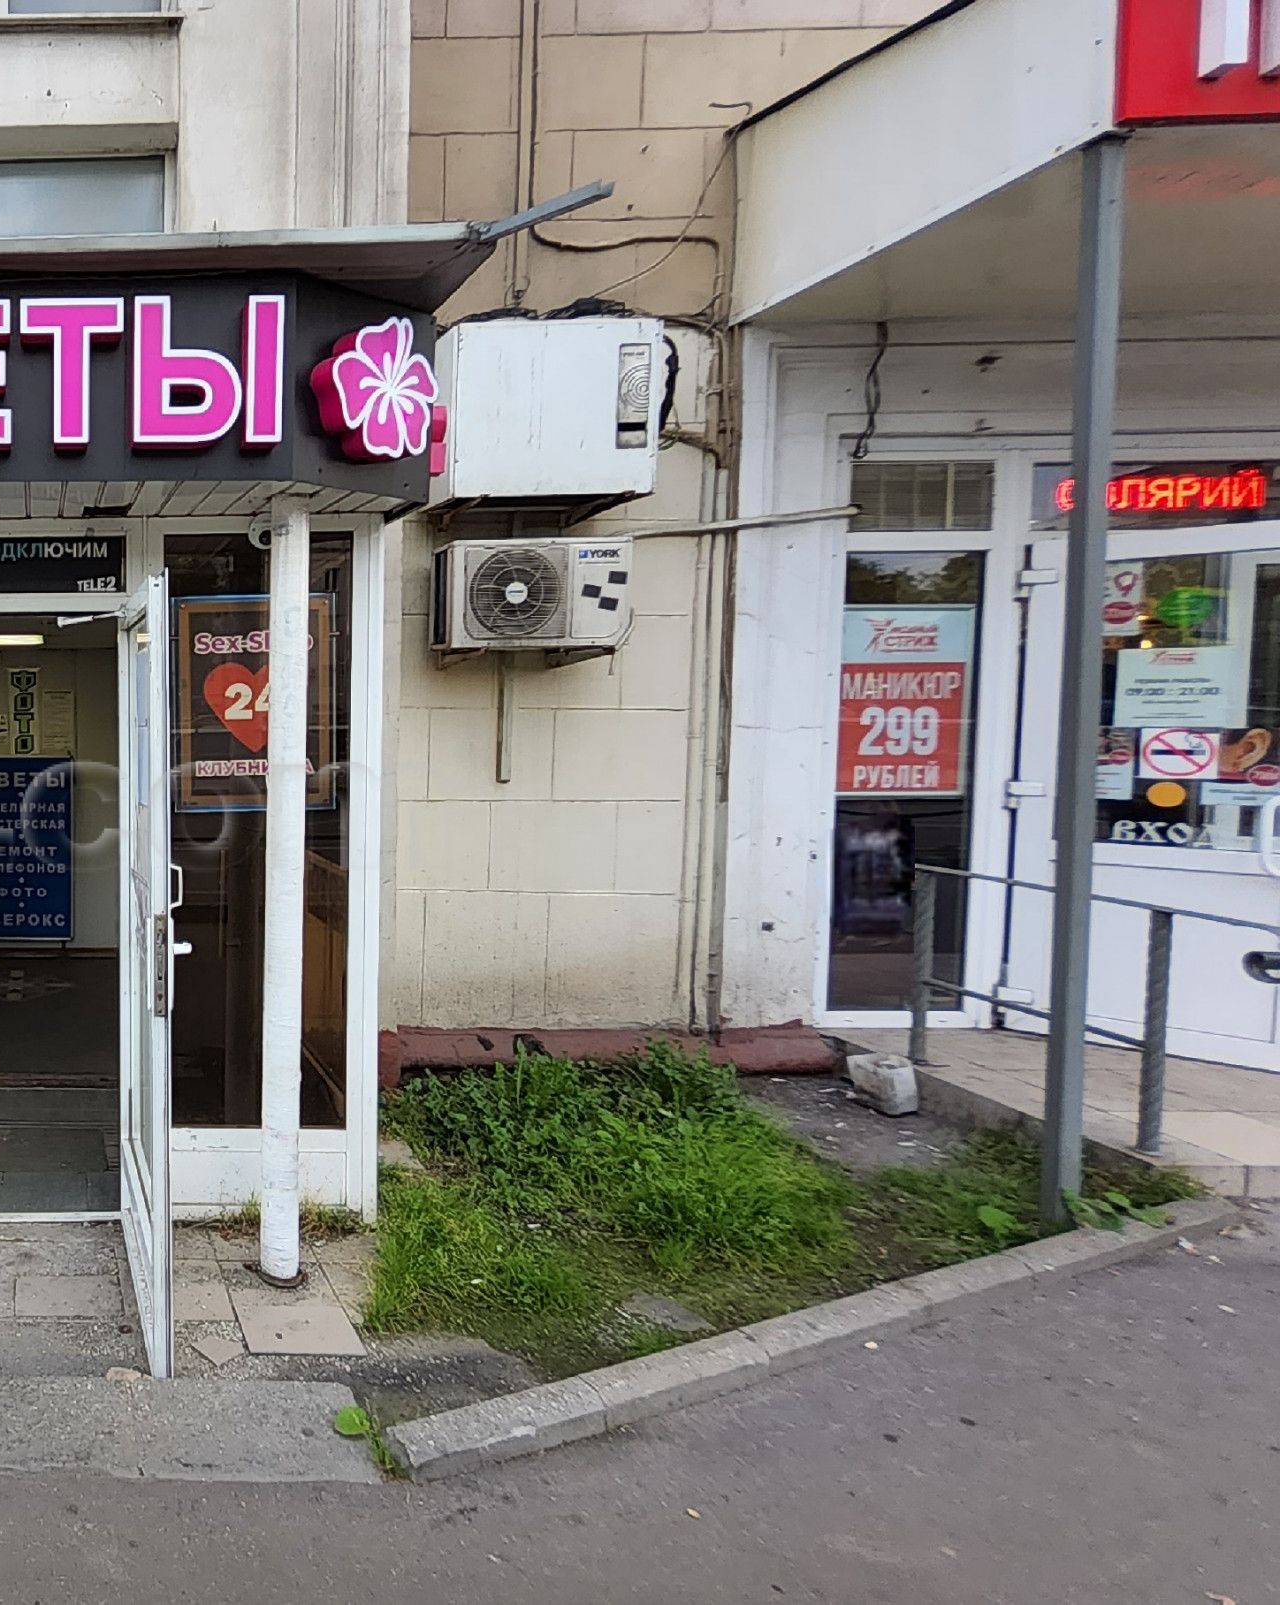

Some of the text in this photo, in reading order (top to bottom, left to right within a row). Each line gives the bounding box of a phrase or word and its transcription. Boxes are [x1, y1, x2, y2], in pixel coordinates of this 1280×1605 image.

[590, 548, 622, 559] YORK
[77, 576, 117, 591] TELE2
[841, 671, 962, 700] МАНИКЮР
[10, 670, 37, 755] ФОТО
[857, 706, 939, 756] 299
[195, 760, 315, 777] КЛУБНИА
[852, 761, 940, 789] РУБЛЕЙ
